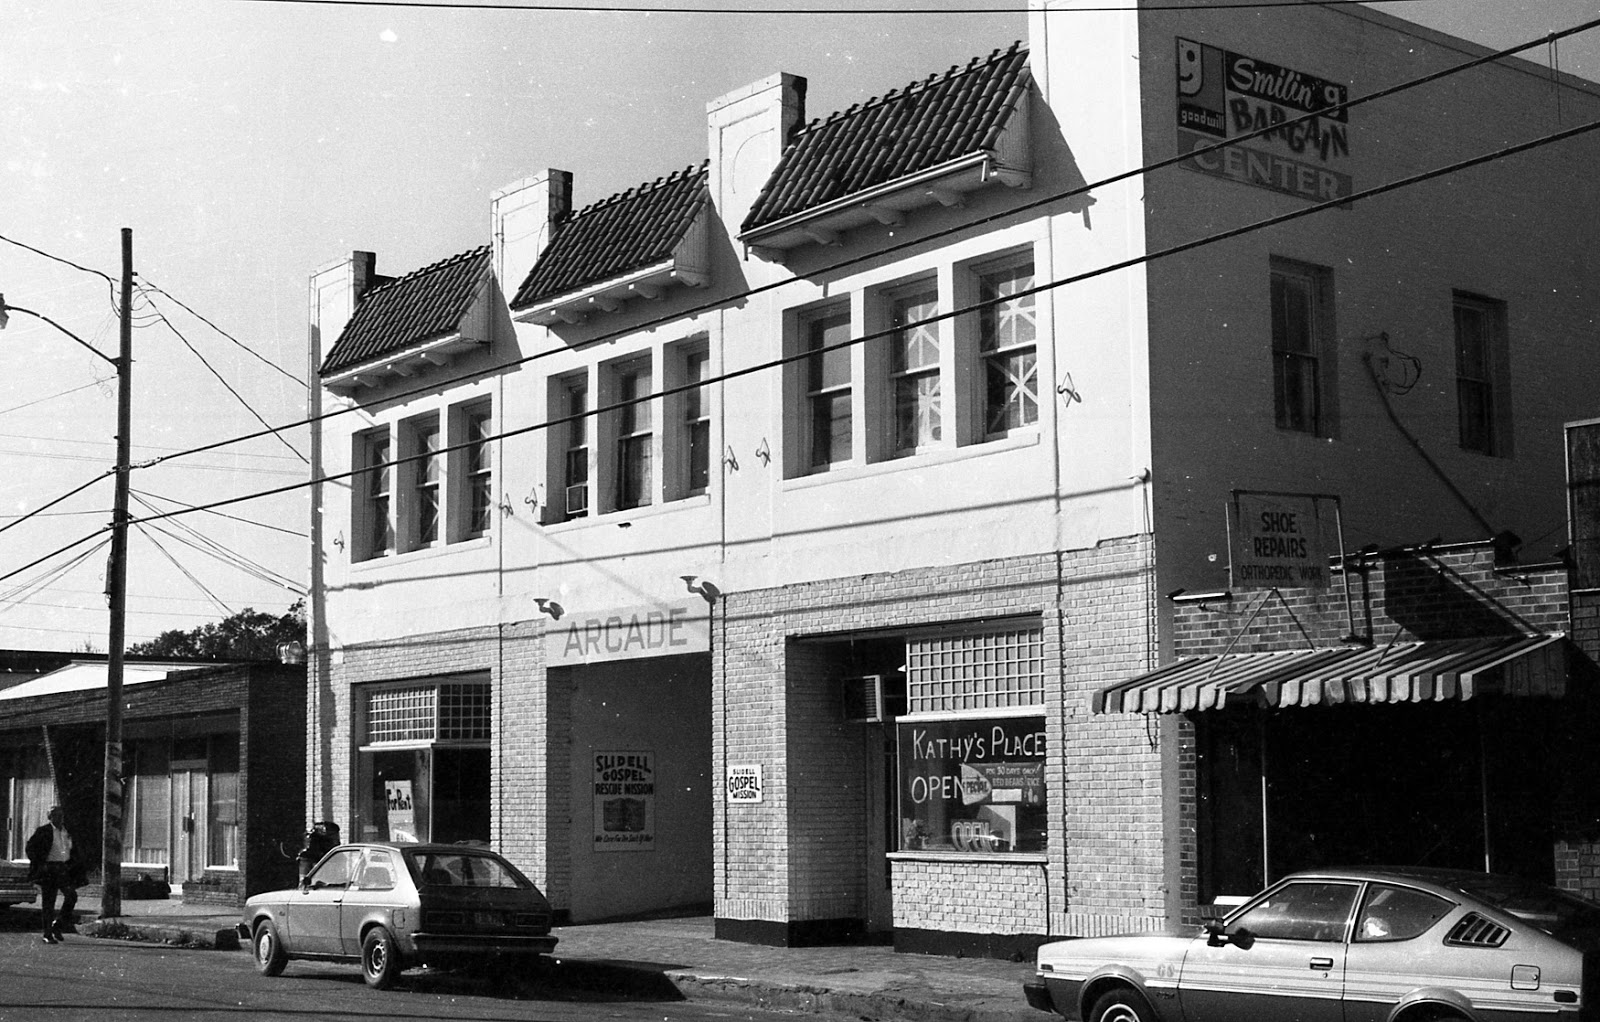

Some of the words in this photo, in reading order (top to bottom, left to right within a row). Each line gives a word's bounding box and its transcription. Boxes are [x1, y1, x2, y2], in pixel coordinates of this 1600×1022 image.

[1182, 110, 1224, 130] goodwill
[1229, 98, 1349, 161] BARGAIN
[1194, 139, 1339, 200] CENTER
[1261, 511, 1297, 533] SHOE
[1254, 537, 1307, 558] REPAIRS
[1241, 565, 1294, 580] ORTHOPEDIC
[563, 607, 688, 658] ARCADE
[992, 726, 1046, 756] PLACE
[595, 755, 652, 774] SLIDELL
[602, 768, 646, 781] GOSPEL
[595, 783, 622, 795] RESCUE
[624, 783, 654, 795] MISSION
[729, 776, 760, 793] GOSPEL
[733, 790, 757, 799] MISSION
[911, 776, 964, 804] OPEN
